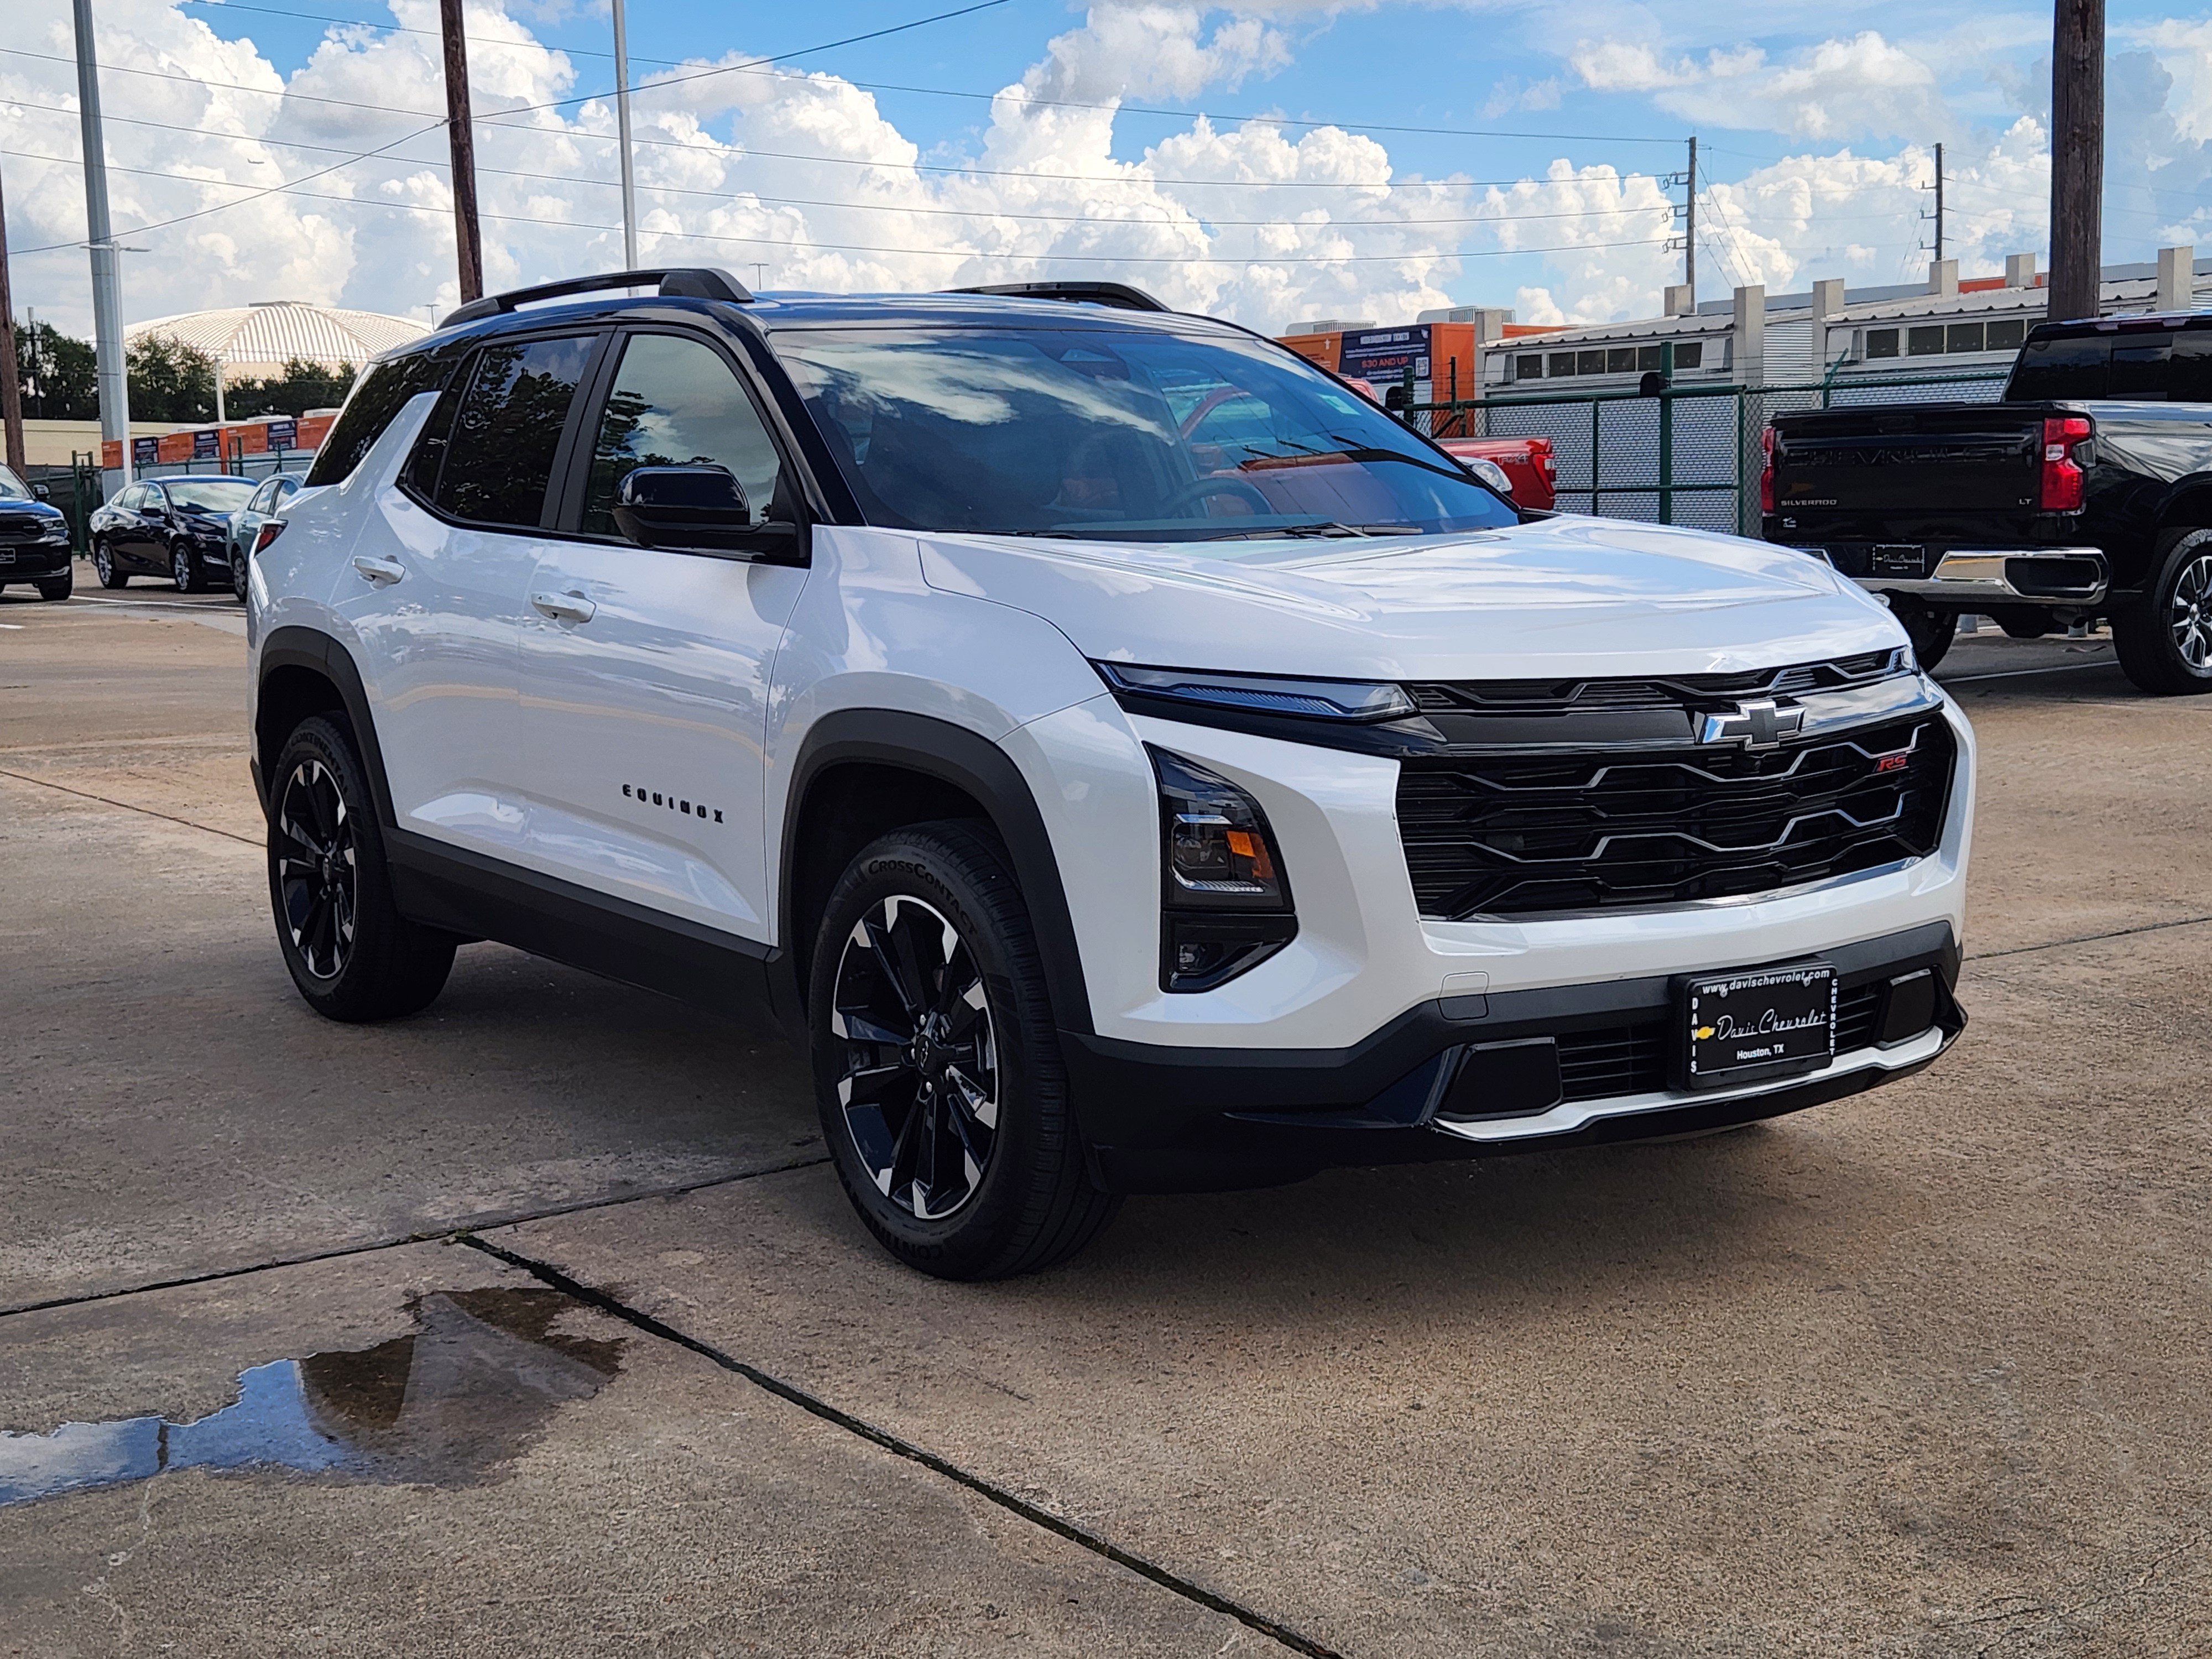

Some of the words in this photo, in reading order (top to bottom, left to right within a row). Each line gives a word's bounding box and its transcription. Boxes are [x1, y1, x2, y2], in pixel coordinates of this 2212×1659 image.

[1379, 358, 1396, 367] AND
[1397, 356, 1408, 366] UP
[1876, 754, 1908, 772] RS
[622, 784, 723, 824] EQUINOX
[1702, 970, 1830, 995] www.davischevrolet.com
[1717, 1015, 1759, 1040] Davis
[1759, 1008, 1828, 1034] Chevrolet
[1829, 978, 1838, 1056] CHEVROLET
[1691, 997, 1699, 1073] DAVIS
[1736, 1047, 1772, 1060] Houston,
[1773, 1044, 1785, 1053] TX
